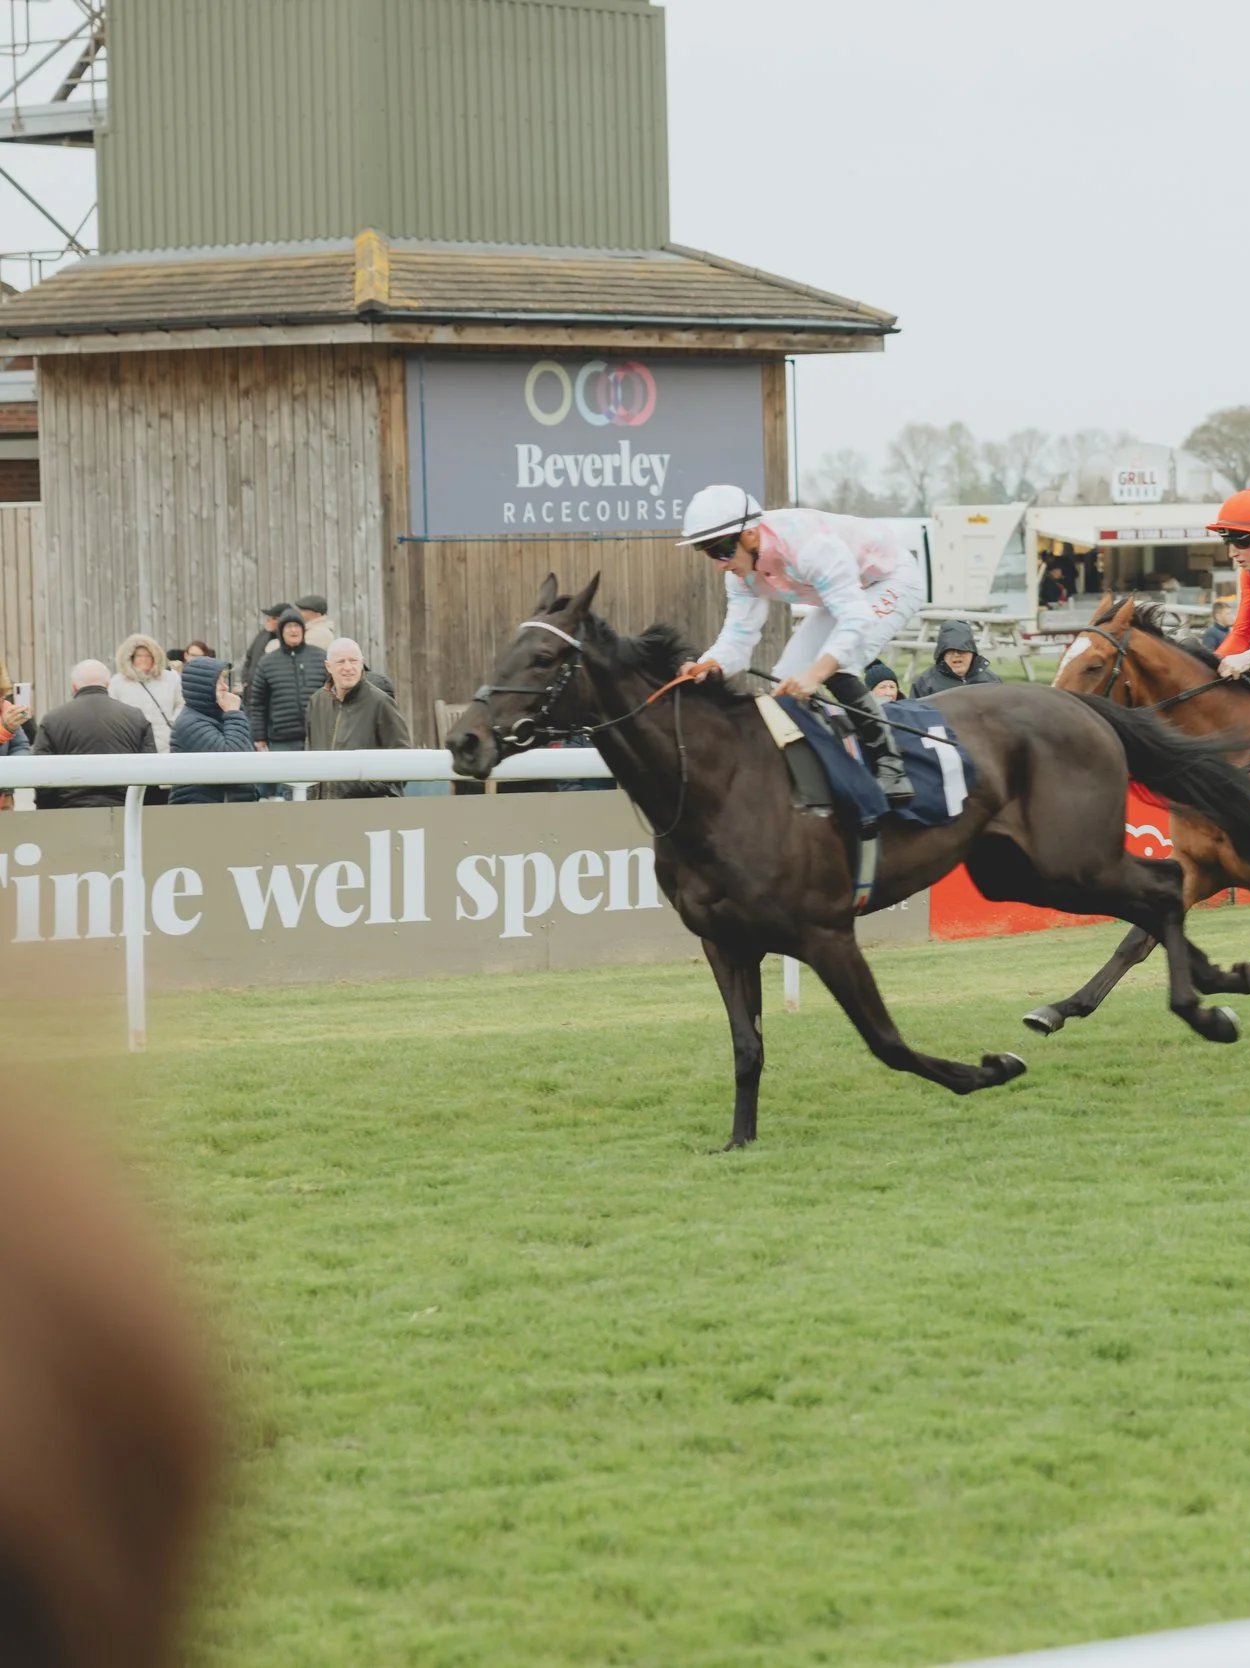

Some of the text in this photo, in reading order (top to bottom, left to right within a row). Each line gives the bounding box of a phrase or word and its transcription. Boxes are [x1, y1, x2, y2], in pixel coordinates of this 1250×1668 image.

[515, 440, 671, 496] Beverley
[1119, 471, 1157, 485] GRILL
[503, 499, 683, 524] RACECOURSE
[921, 726, 968, 817] 1
[227, 828, 432, 930] well
[456, 847, 664, 938] spen
